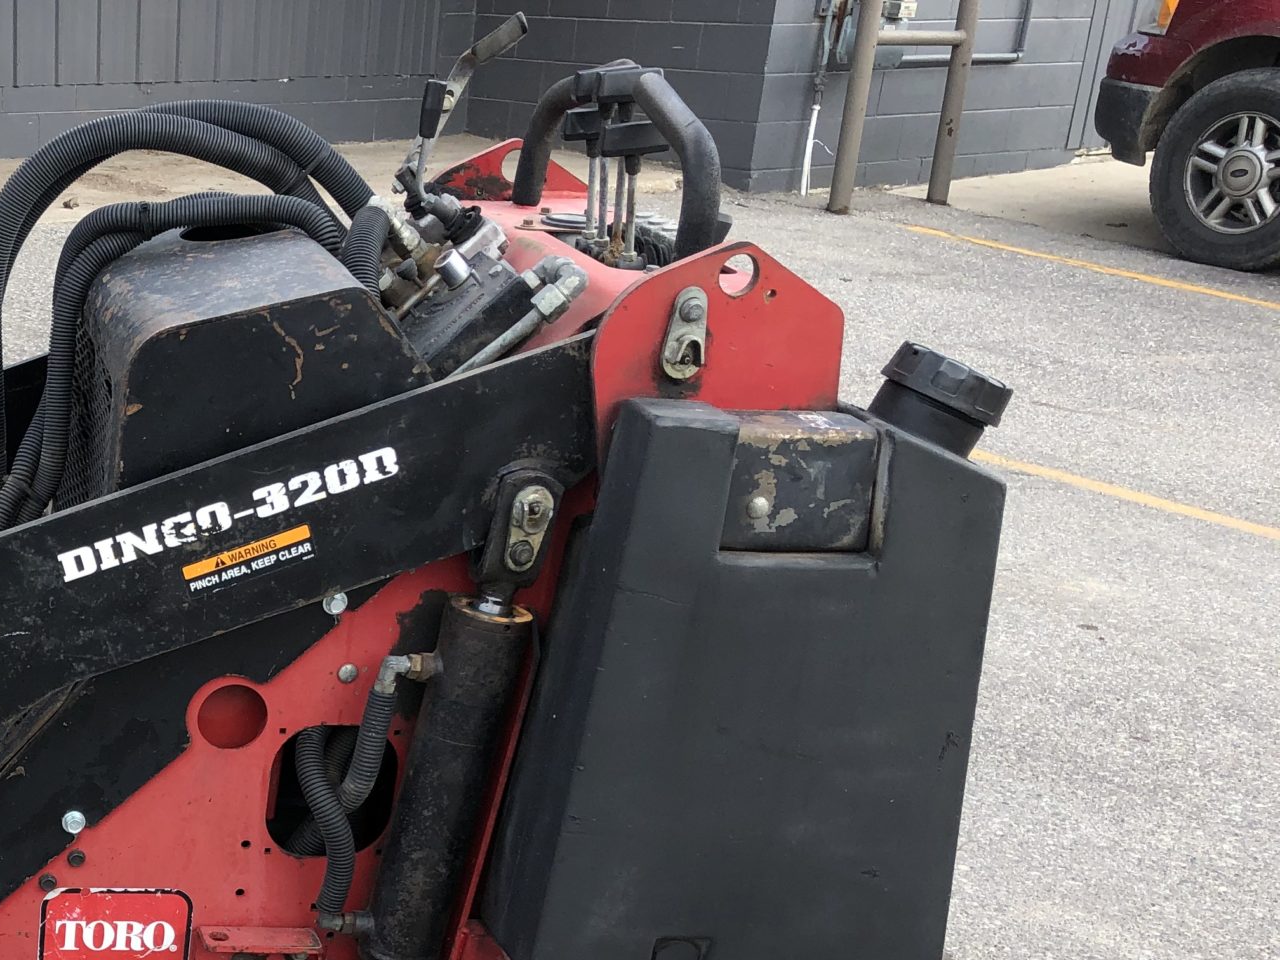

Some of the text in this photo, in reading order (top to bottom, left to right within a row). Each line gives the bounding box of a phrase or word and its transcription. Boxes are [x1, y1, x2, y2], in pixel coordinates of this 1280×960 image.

[189, 542, 312, 592] PINCH AREA, KEEP CLEAR
[228, 540, 277, 563] WARNING
[55, 920, 175, 952] TORO
